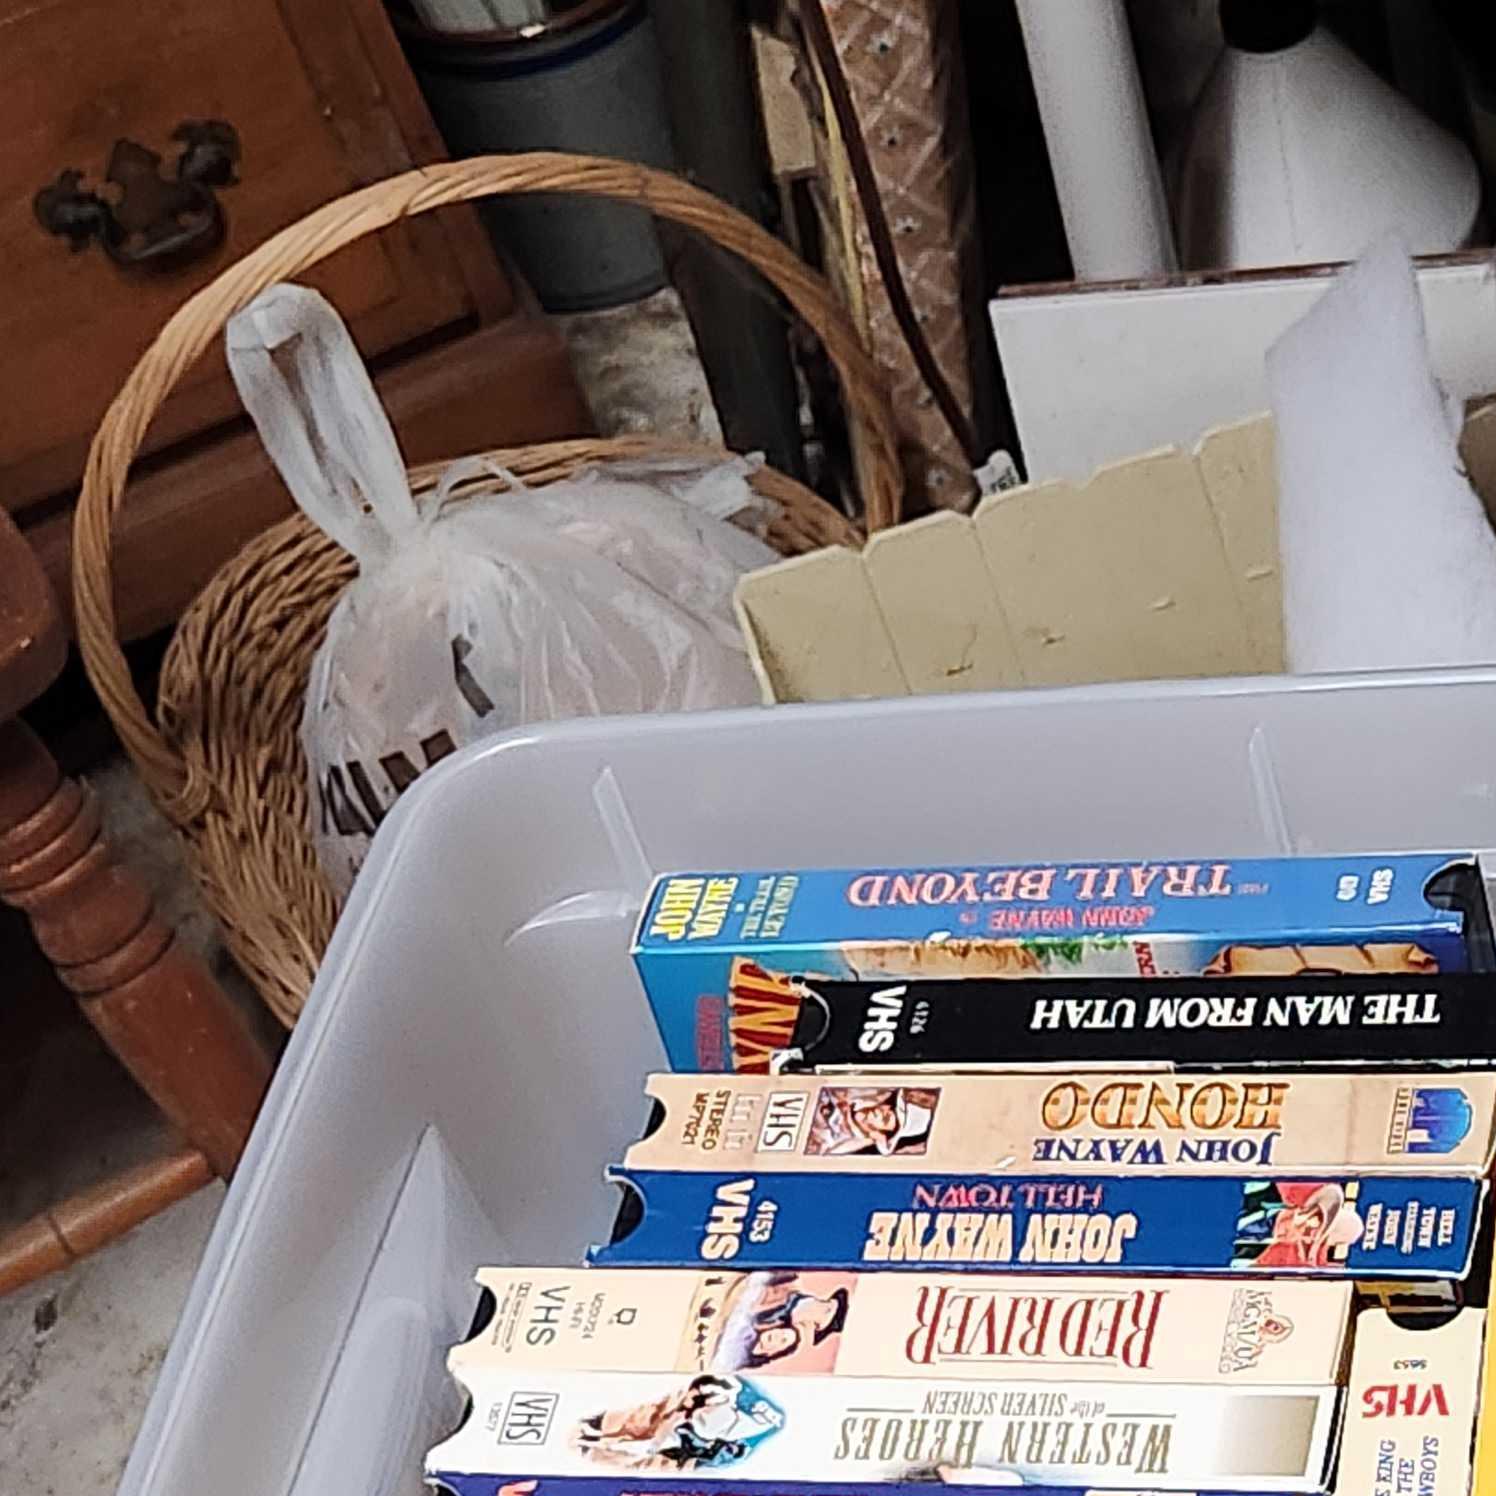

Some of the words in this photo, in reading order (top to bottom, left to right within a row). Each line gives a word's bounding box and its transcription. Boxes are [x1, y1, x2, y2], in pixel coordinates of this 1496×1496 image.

[846, 867, 1058, 907] BEYOND
[1064, 863, 1232, 899] TRAIL
[650, 877, 704, 941] JOHN
[687, 875, 739, 940] WAYNE
[858, 985, 908, 1054] VHS
[1029, 998, 1137, 1031] UTAH
[1144, 997, 1258, 1029] FROM
[1264, 995, 1356, 1027] MAN
[1362, 993, 1441, 1026] THE
[701, 1089, 732, 1151] STEREO
[762, 1095, 802, 1149] VHS
[1041, 1080, 1291, 1131] HONDO
[1031, 1137, 1168, 1165] WAYNE
[1176, 1132, 1281, 1166] JOHN
[912, 1183, 1015, 1210] TOWN
[1025, 1183, 1104, 1210] HELL
[699, 1177, 757, 1262] VHS
[862, 1210, 1014, 1262] WAYNE
[1017, 1211, 1139, 1264] JOHN
[525, 1283, 572, 1347] VHS
[504, 1397, 552, 1443] VHS
[922, 1391, 999, 1417] SCREEN
[1000, 1392, 1069, 1417] SILVER
[1361, 1383, 1450, 1419] VHS
[833, 1417, 984, 1470] HEROES
[999, 1420, 1174, 1476] WESTERN
[1375, 1439, 1396, 1484] KING
[1395, 1457, 1415, 1494] THE
